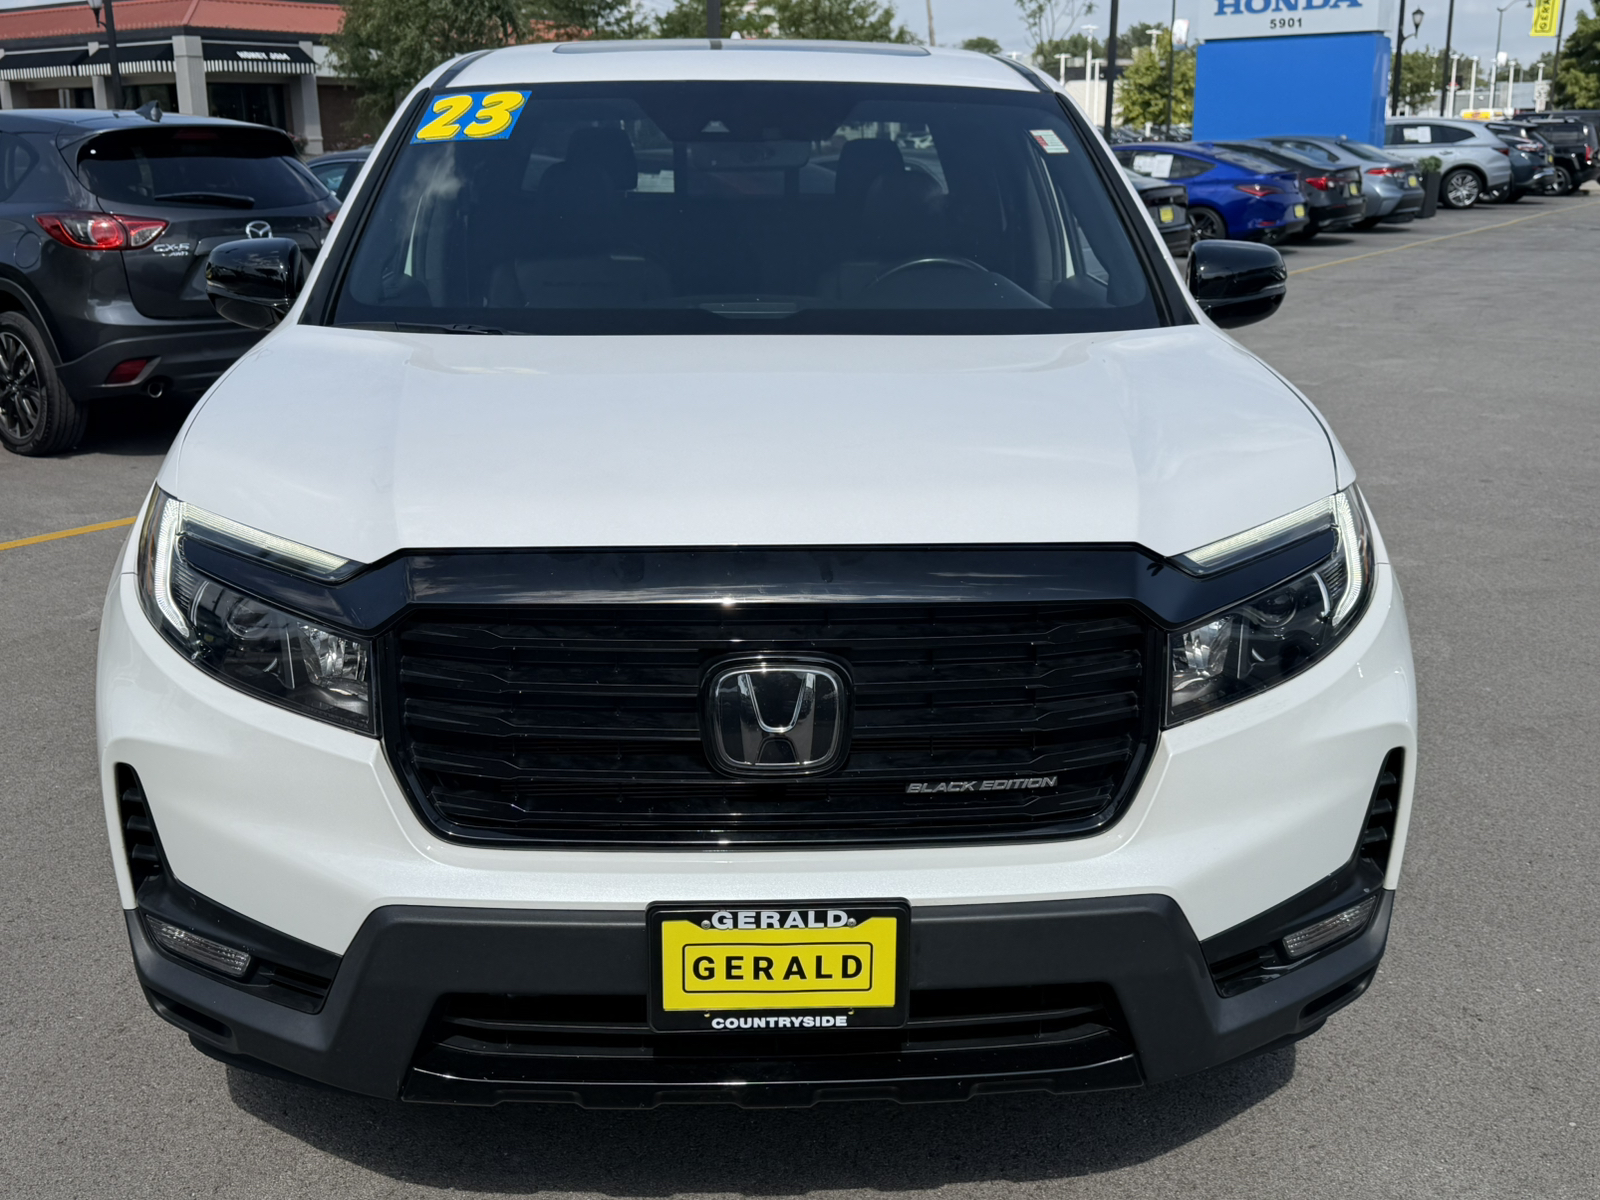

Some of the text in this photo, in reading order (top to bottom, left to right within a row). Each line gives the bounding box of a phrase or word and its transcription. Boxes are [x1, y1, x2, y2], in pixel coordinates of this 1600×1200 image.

[1269, 17, 1303, 29] 5901
[416, 91, 524, 141] 23
[153, 242, 190, 252] CX-5
[906, 776, 1058, 793] BLACK EDITION
[711, 910, 848, 930] GERALD
[692, 954, 864, 981] GERALD
[711, 1016, 848, 1029] COUNTRYSIDE
